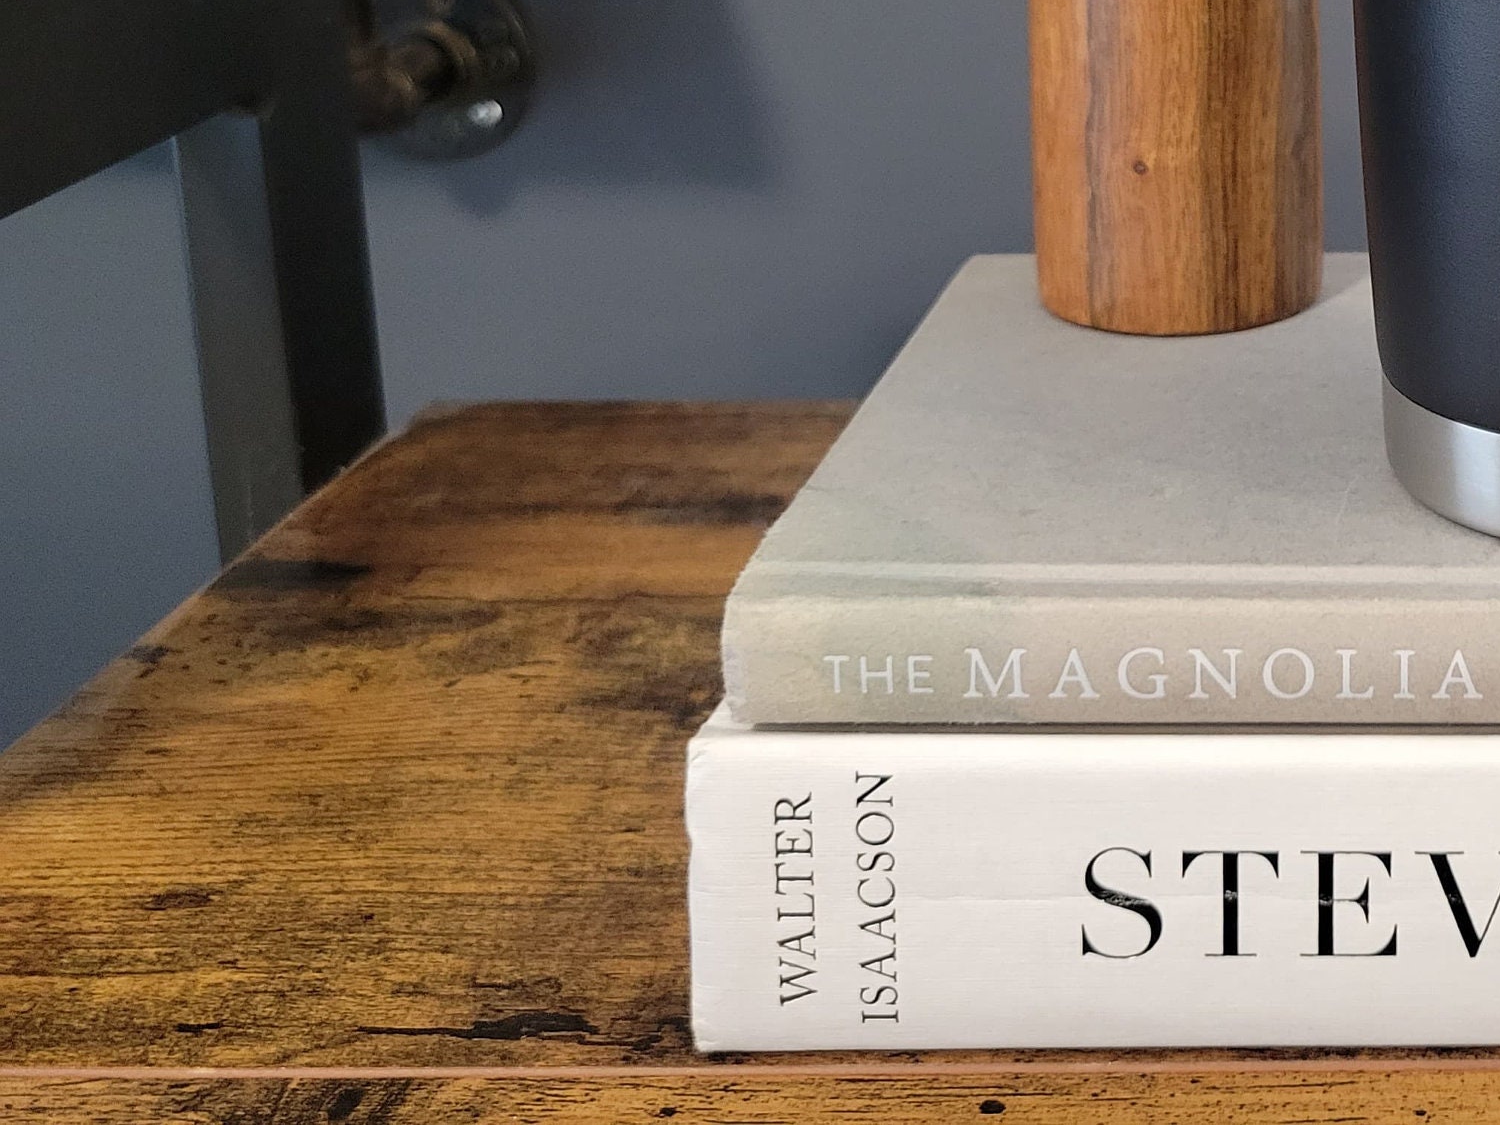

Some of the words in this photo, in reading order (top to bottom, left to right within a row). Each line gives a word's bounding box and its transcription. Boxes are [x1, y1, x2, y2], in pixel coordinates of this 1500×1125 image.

[822, 654, 935, 694] THE
[963, 647, 1483, 700] MAGNOLIA
[774, 792, 818, 1006] WALTER
[856, 771, 899, 1023] ISAACSON
